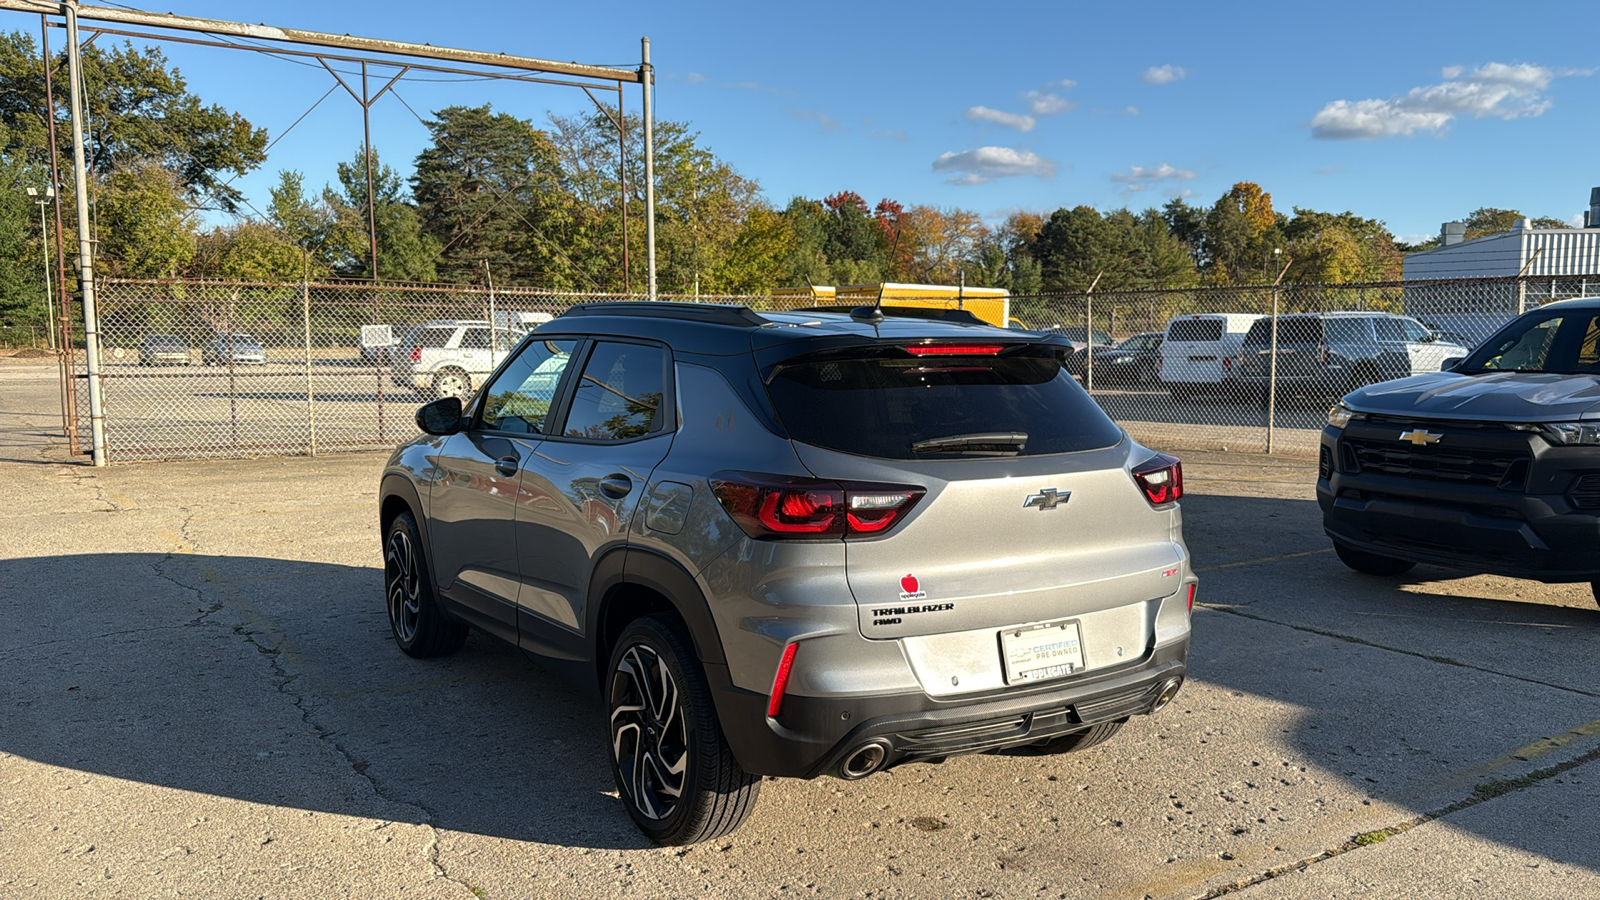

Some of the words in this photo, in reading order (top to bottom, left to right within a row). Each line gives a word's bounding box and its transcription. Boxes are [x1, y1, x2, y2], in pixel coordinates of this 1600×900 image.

[872, 603, 954, 616] TRAILBLAZER
[873, 617, 902, 626] AWD
[1033, 640, 1077, 653] CERTIFIED
[1036, 651, 1050, 660] PRE
[1053, 647, 1077, 657] OWNED
[673, 661, 691, 708] Continental
